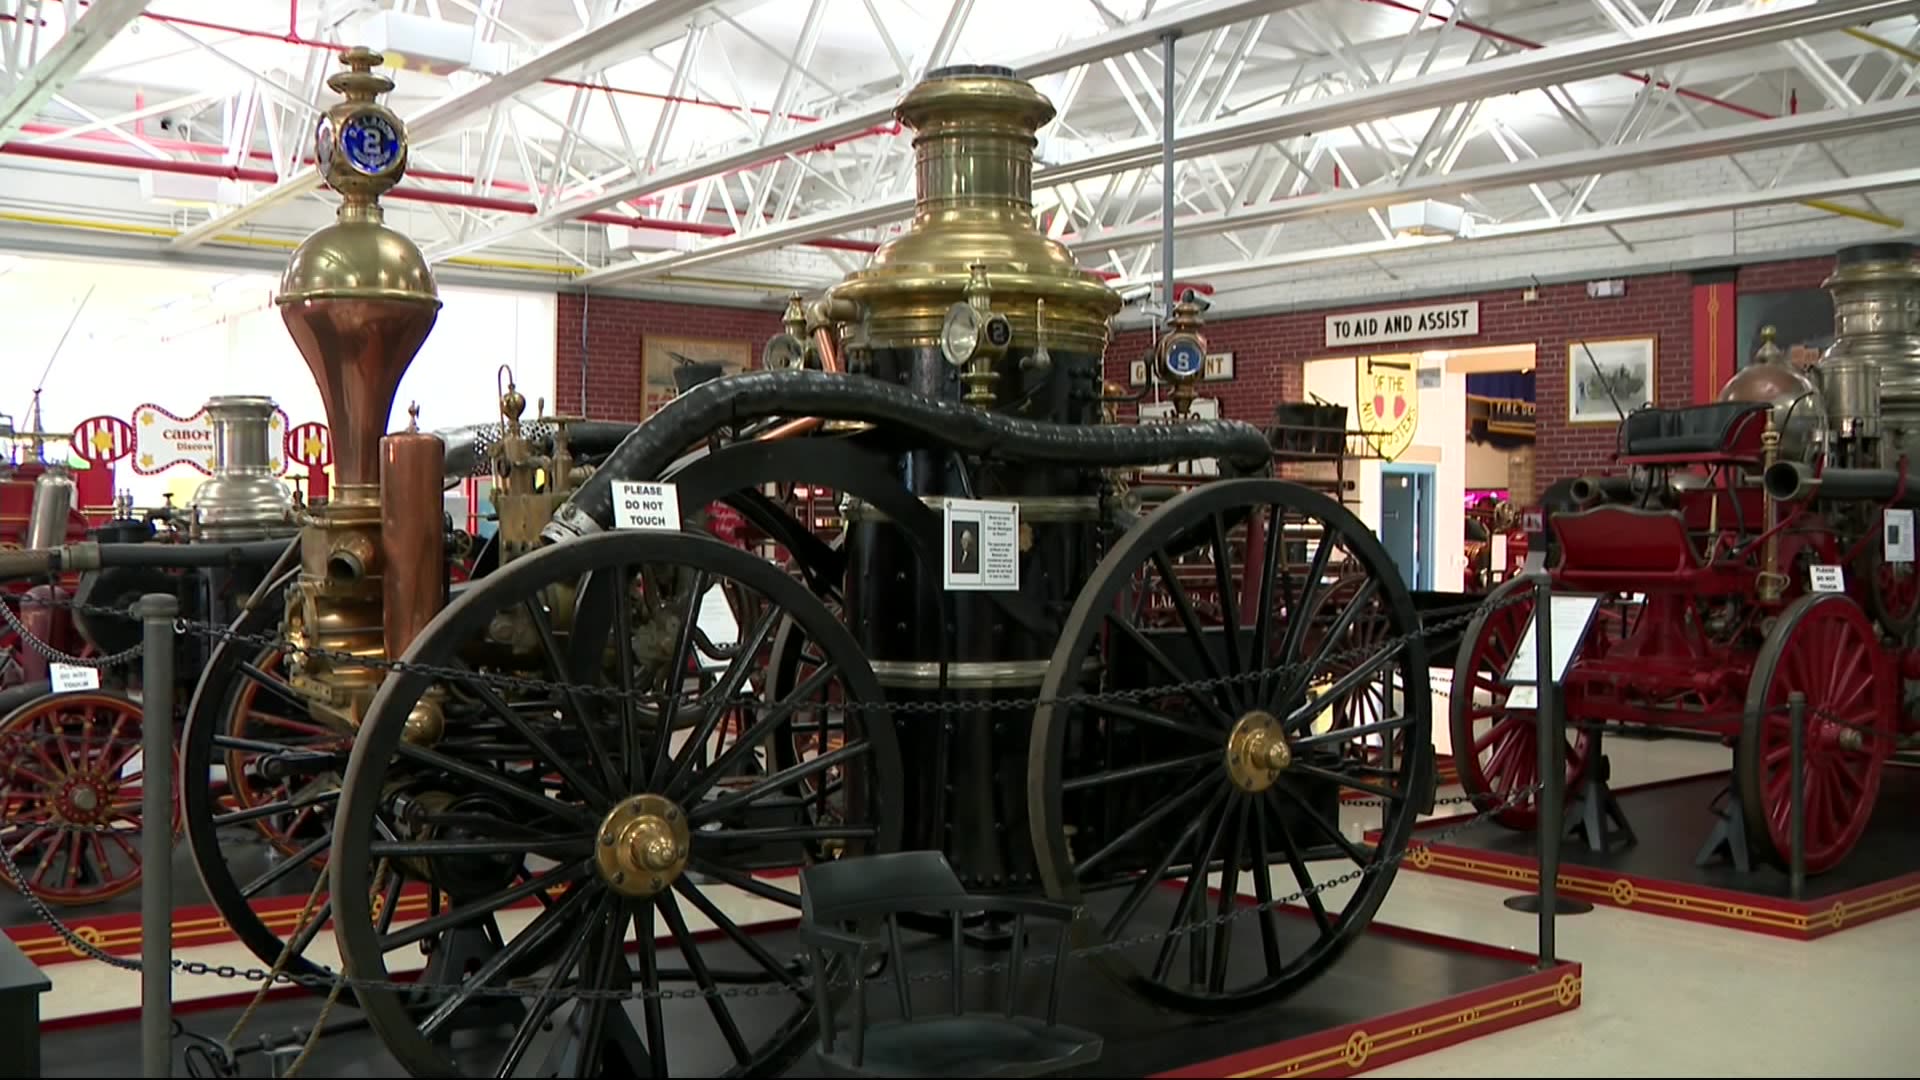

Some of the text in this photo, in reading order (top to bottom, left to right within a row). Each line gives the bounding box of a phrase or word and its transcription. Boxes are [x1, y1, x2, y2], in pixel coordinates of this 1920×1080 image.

[363, 128, 382, 155] 2
[1334, 309, 1469, 338] TO AID AND ASSIST
[1388, 376, 1405, 392] THE
[624, 485, 662, 495] PLEASE
[625, 500, 663, 511] DO NOT
[630, 515, 666, 526] TOUCH
